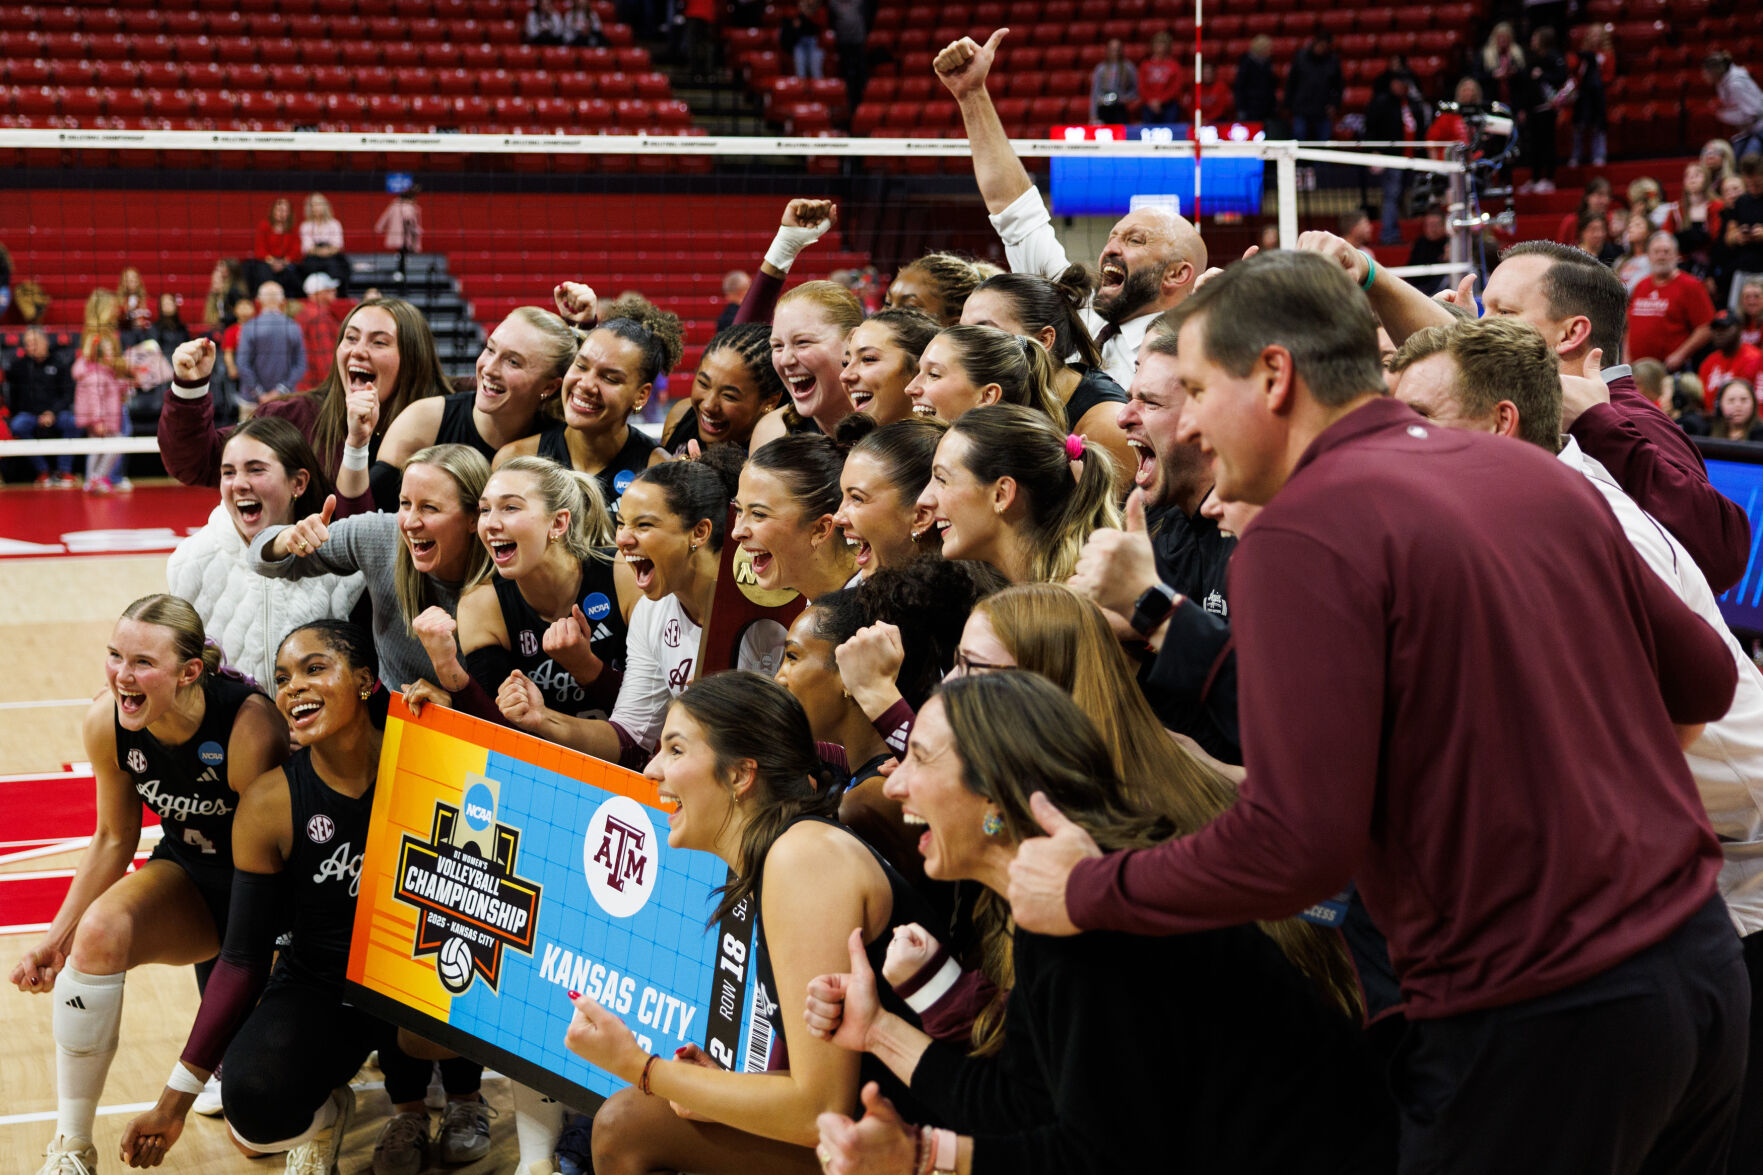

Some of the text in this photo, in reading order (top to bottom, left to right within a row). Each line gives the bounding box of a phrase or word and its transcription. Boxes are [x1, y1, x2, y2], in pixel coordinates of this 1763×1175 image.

[588, 602, 610, 615] NCAA
[127, 749, 147, 772] SEC
[201, 752, 223, 760] NCAA
[136, 780, 233, 822] Aggies
[465, 802, 493, 823] NCAA
[183, 828, 217, 854] 4
[309, 816, 333, 841] SEC
[436, 855, 501, 897] VOLLEYBALL
[462, 853, 489, 870] WOMEN'S
[404, 865, 528, 934] CHAMPIONSHIP
[427, 911, 447, 928] 2025
[450, 921, 478, 942] KANSAS
[478, 933, 496, 949] CITY
[720, 932, 747, 983] 18
[539, 943, 636, 1015] KANSAS
[637, 986, 697, 1042] CITY
[719, 979, 737, 1022] ROW
